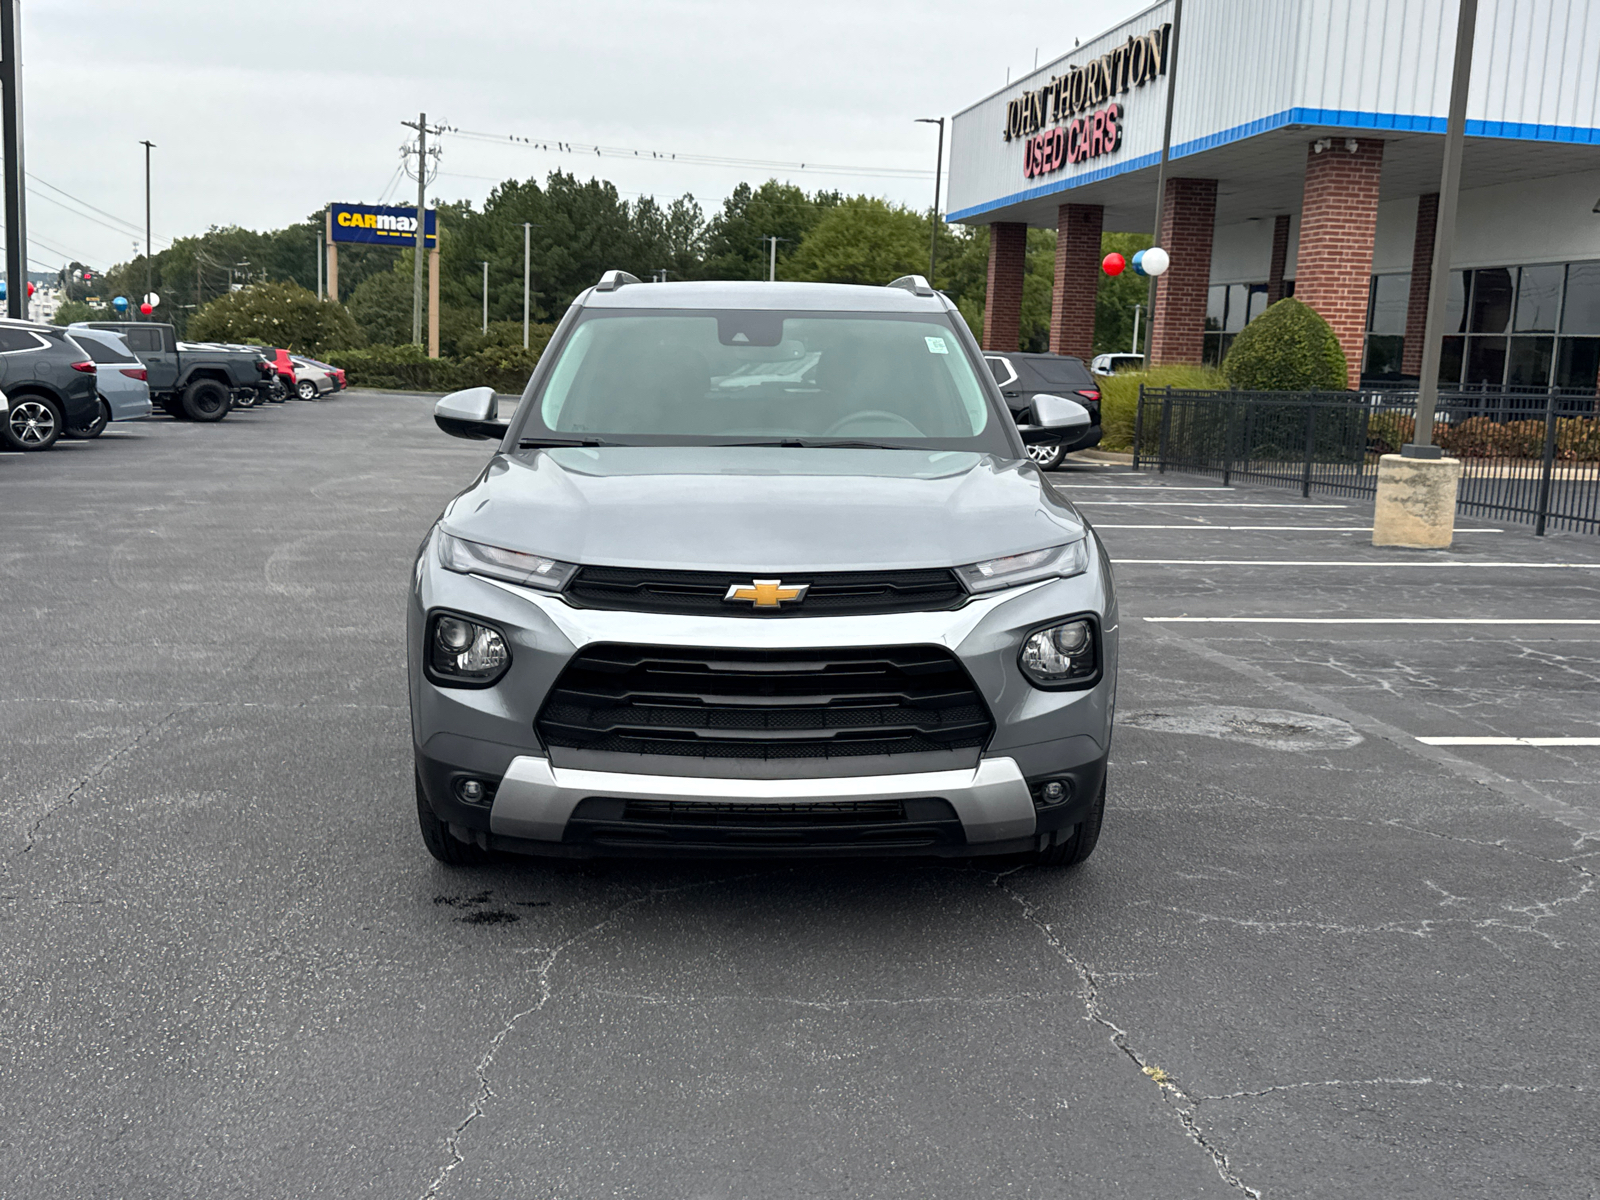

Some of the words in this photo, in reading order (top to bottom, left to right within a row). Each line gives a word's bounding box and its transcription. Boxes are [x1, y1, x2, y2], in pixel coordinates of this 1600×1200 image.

[1003, 86, 1050, 142] JOHN
[1050, 23, 1172, 123] THORNTON
[1023, 126, 1067, 178] USED
[1067, 103, 1124, 164] CARS
